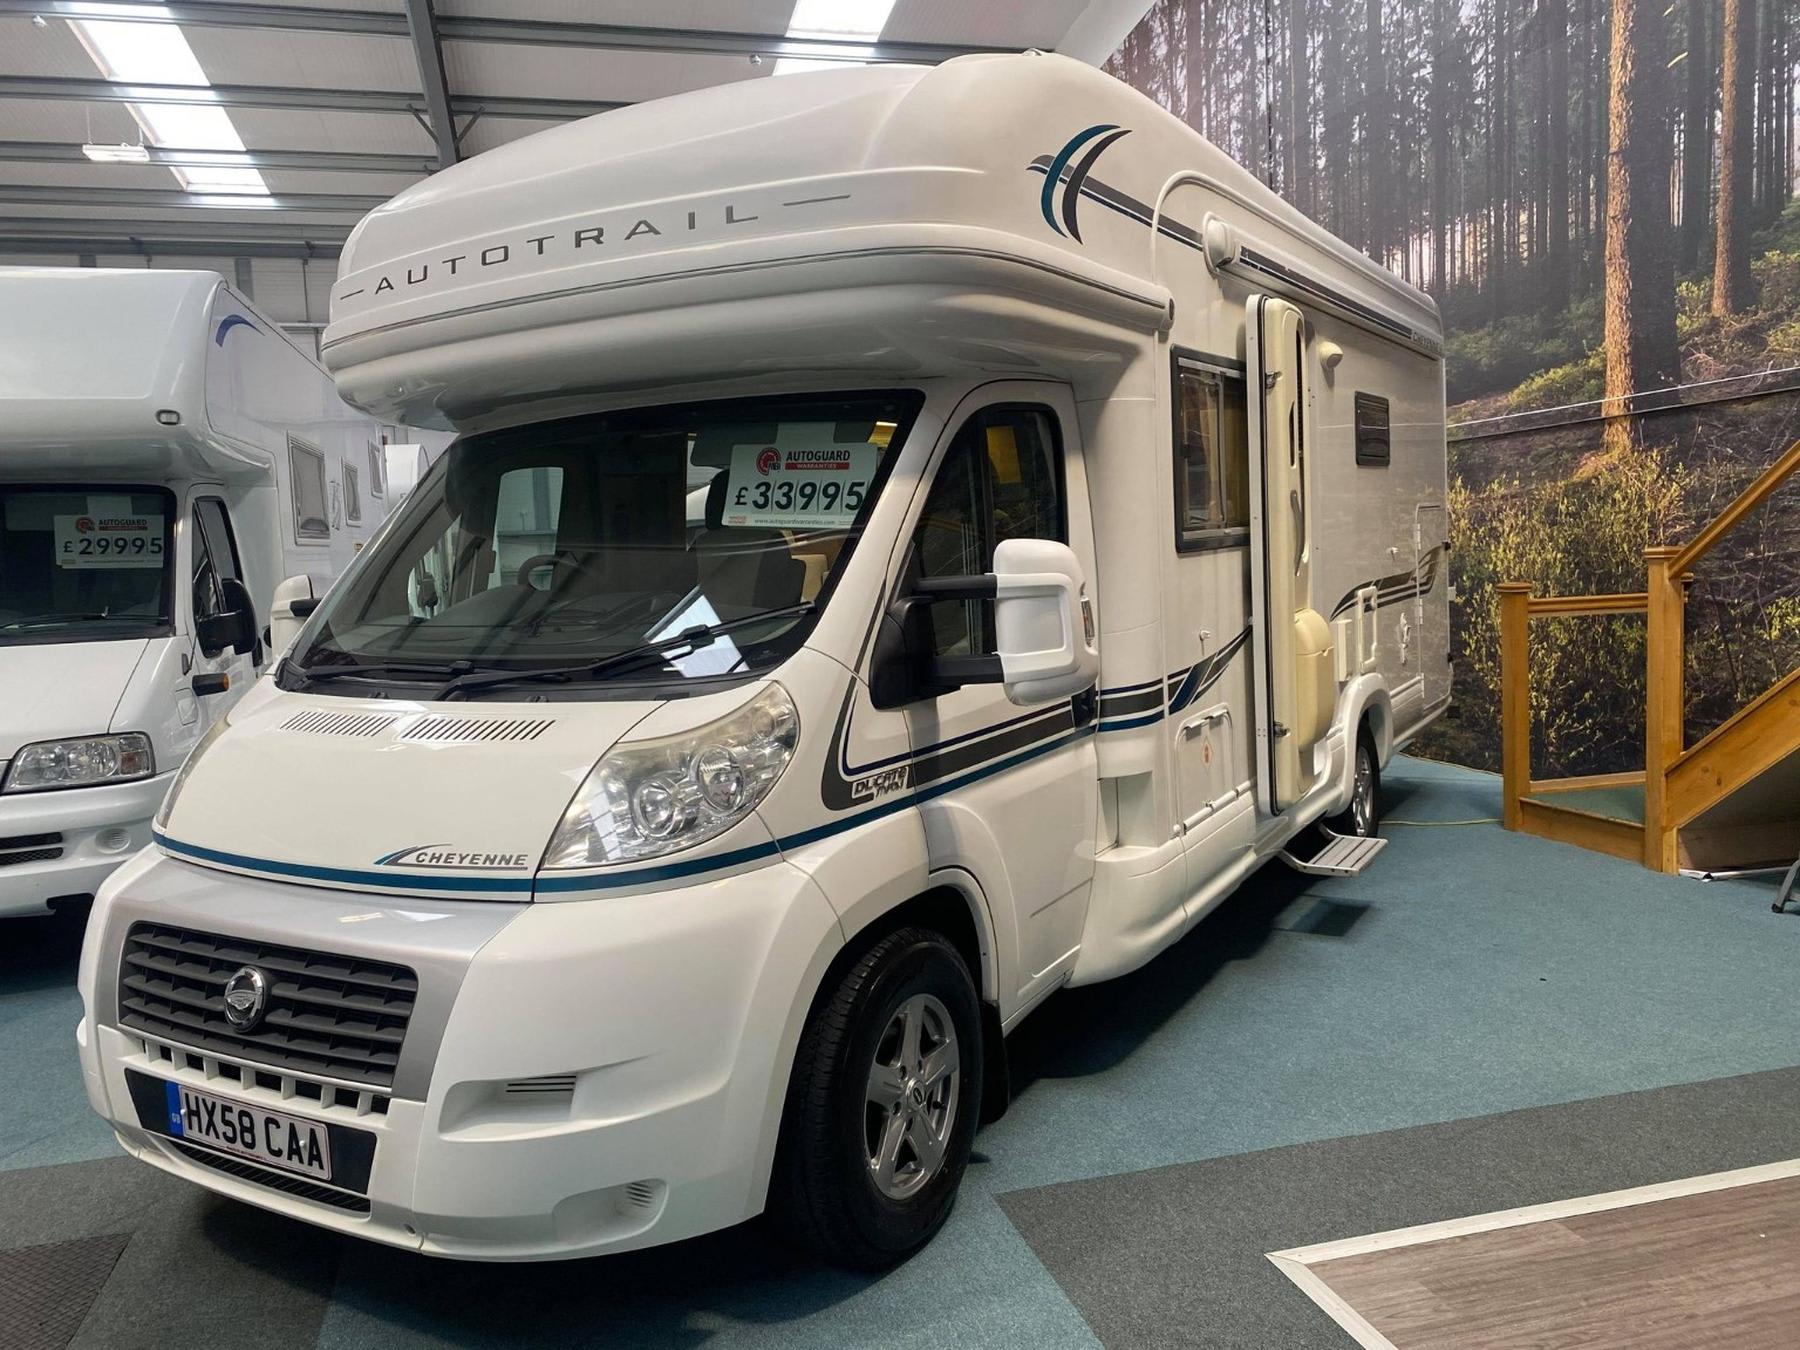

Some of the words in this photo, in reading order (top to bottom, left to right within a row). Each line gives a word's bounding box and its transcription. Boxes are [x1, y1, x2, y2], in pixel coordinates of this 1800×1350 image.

[374, 204, 759, 296] AUTOTRAIL
[786, 450, 850, 461] AUTOGUARD
[415, 851, 529, 866] CHEYENNE
[184, 1092, 256, 1151] HX58
[264, 1116, 325, 1171] CAA
